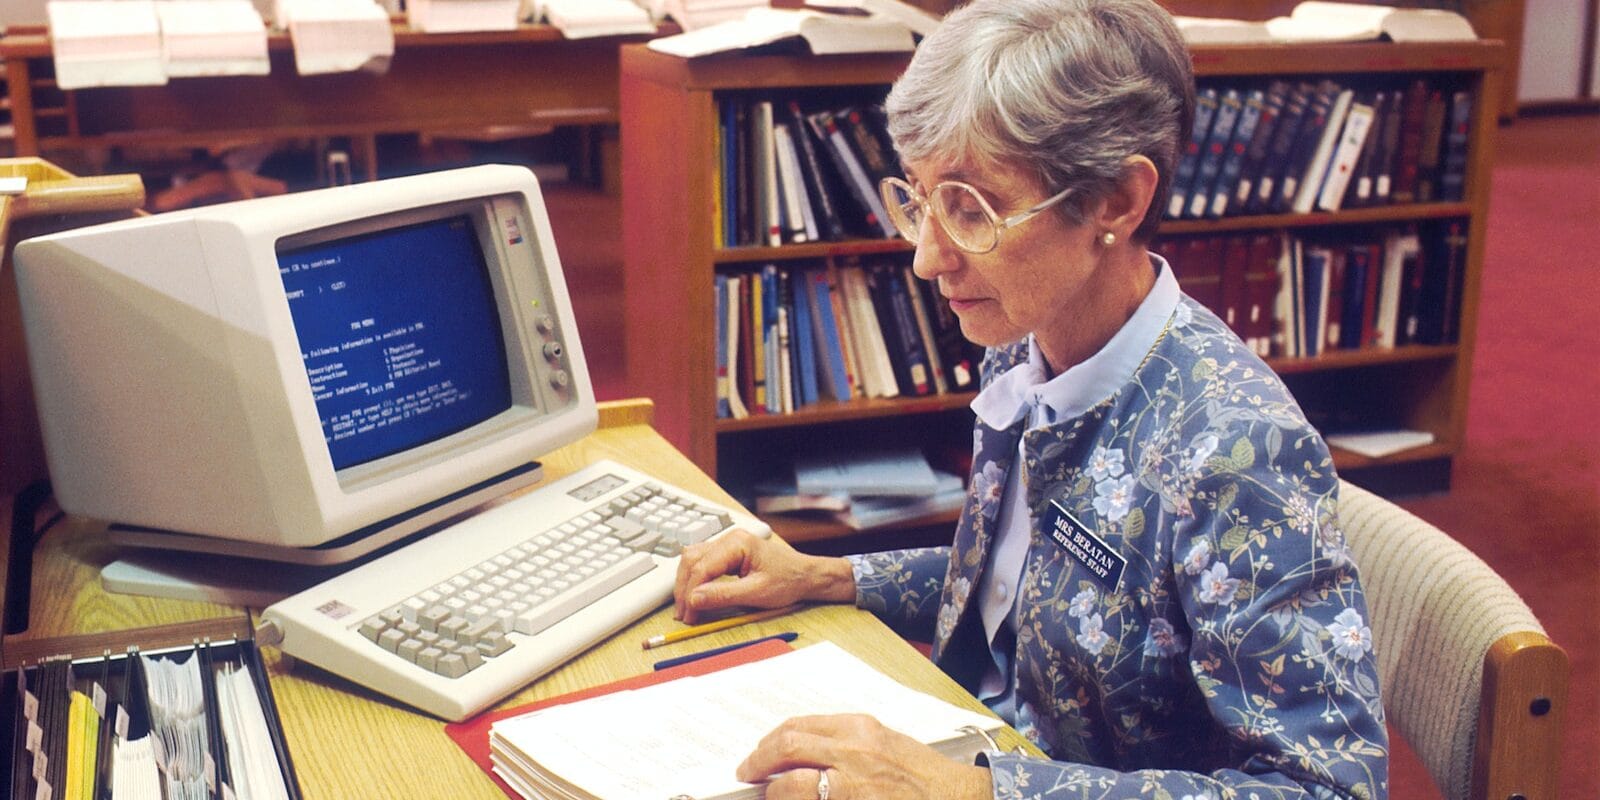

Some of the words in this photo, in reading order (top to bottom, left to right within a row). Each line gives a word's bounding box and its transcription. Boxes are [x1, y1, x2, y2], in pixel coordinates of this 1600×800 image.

[310, 346, 340, 358] following
[342, 337, 374, 350] information
[383, 327, 407, 340] available
[308, 362, 344, 376] Description
[310, 370, 348, 384] Instructions
[371, 384, 384, 394] Exit
[1055, 515, 1074, 538] MRS
[1073, 532, 1114, 569] BERATAN
[1053, 529, 1088, 562] REFERENCE
[1086, 558, 1108, 578] STAFF
